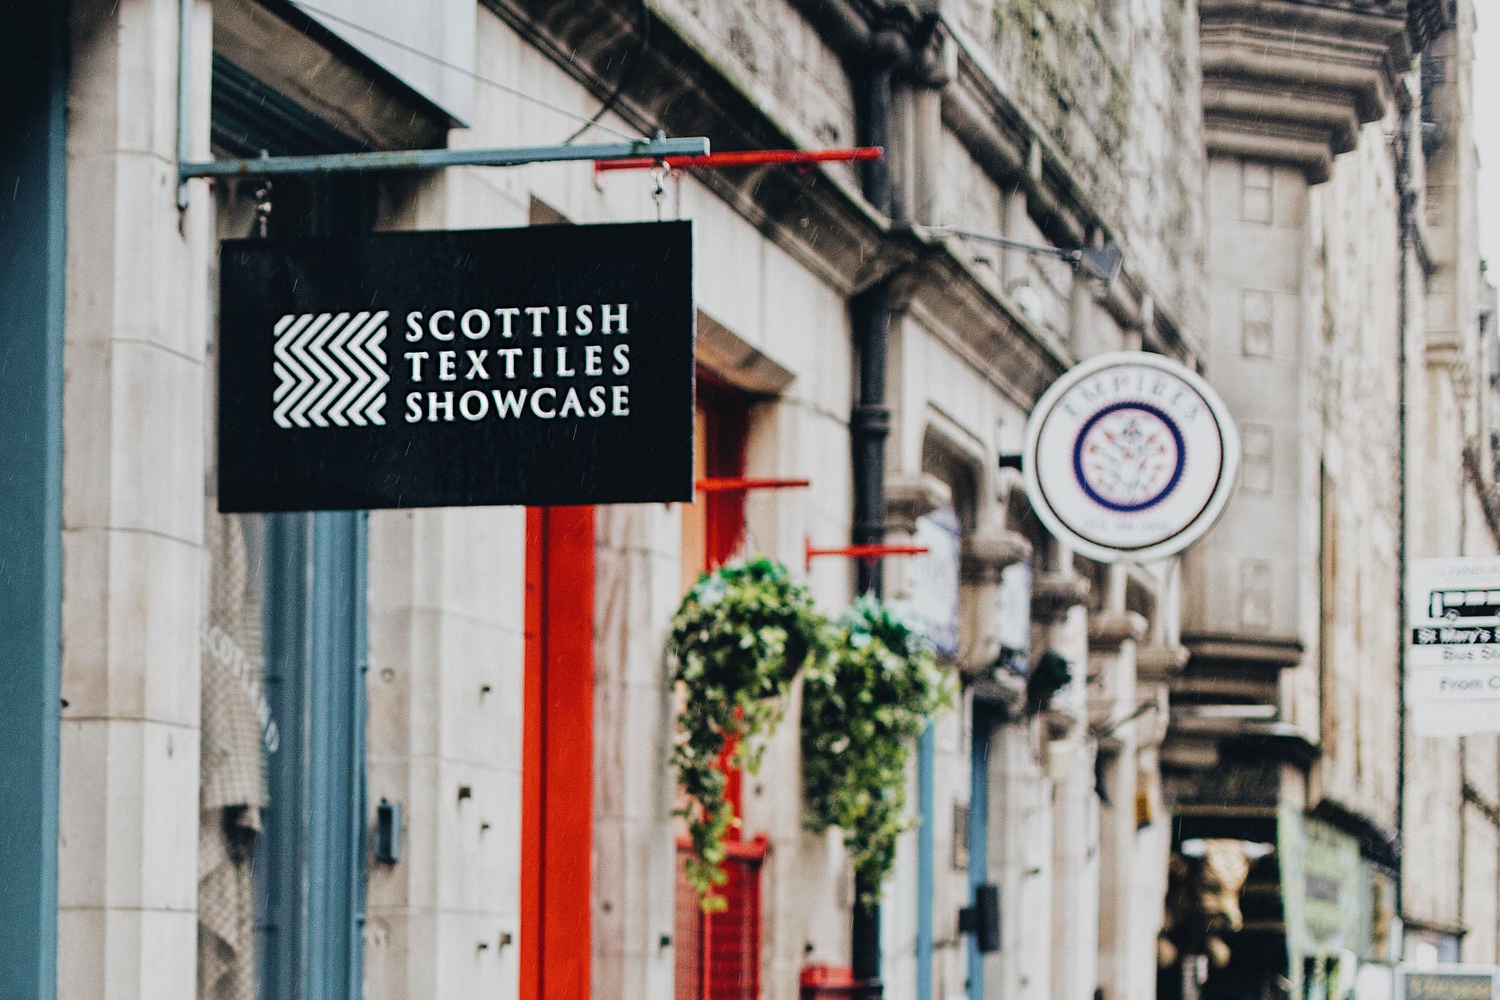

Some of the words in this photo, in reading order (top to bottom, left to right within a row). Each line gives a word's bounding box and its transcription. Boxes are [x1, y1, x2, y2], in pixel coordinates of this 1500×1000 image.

[405, 303, 629, 342] SCOTTISH
[403, 344, 630, 382] TEXTILES
[404, 385, 630, 424] SHOWCASE
